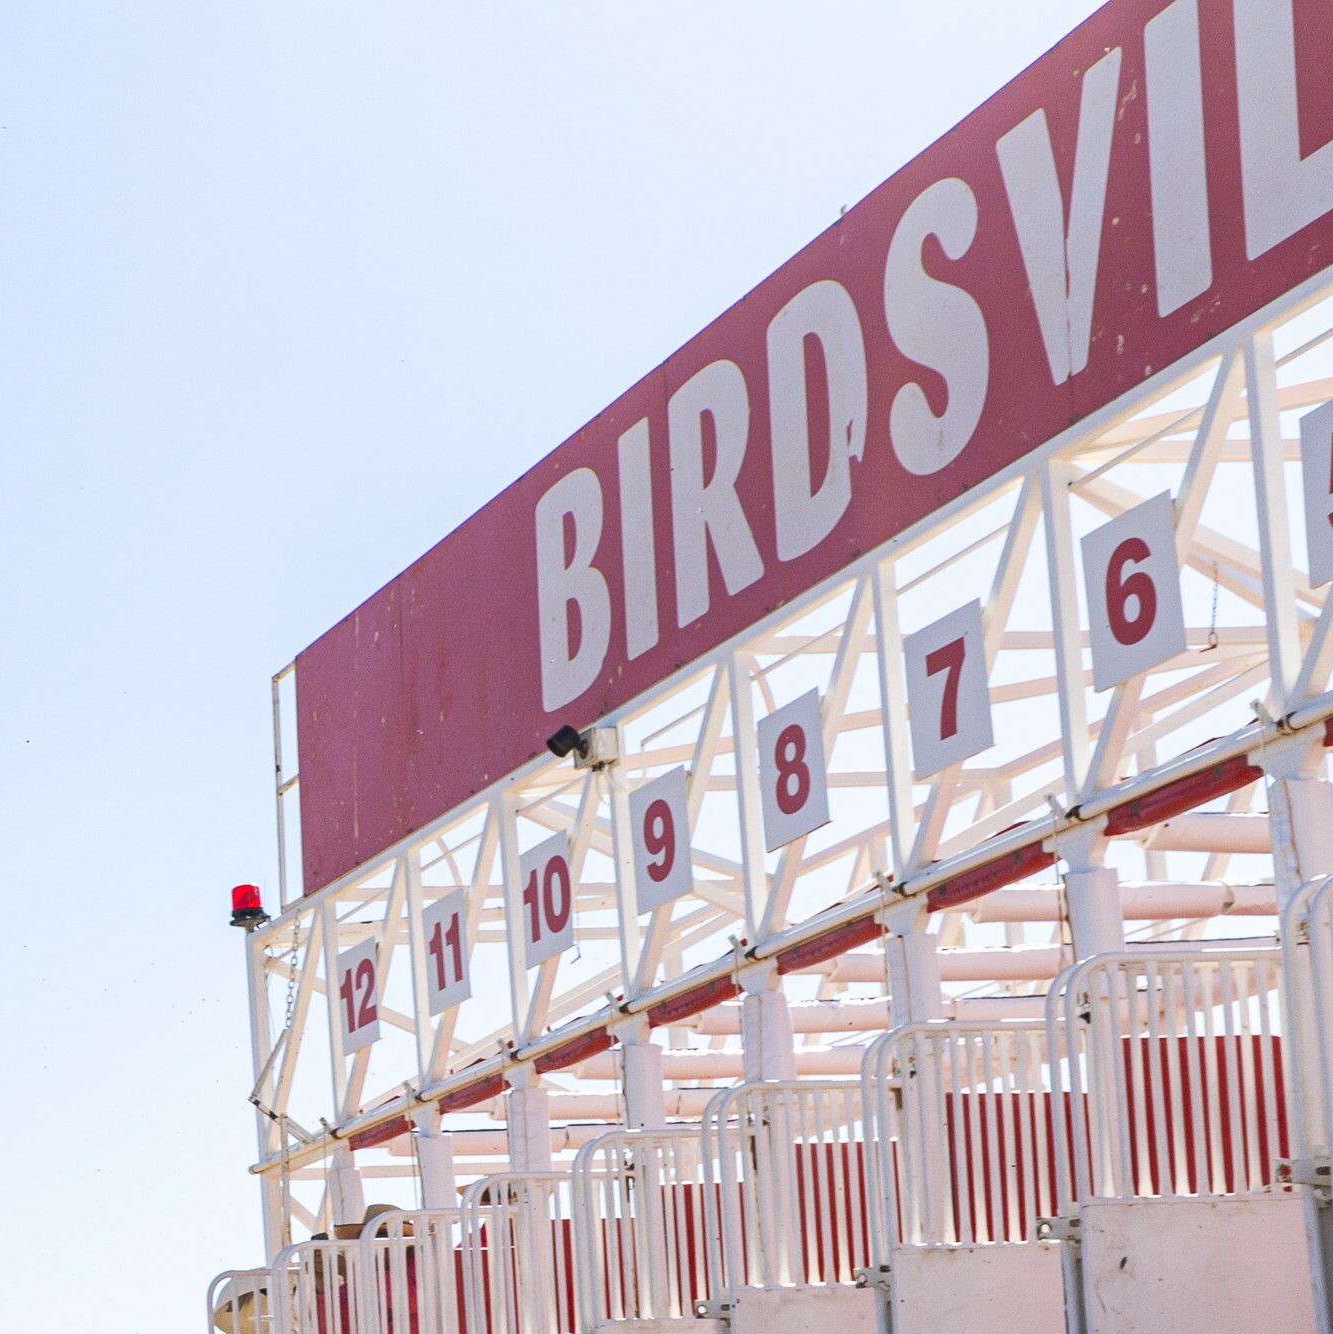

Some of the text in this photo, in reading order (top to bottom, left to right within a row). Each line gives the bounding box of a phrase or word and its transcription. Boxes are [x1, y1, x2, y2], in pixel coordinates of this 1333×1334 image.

[534, 0, 1333, 714] BIRDSVIL
[1105, 538, 1156, 646] 6
[924, 637, 965, 740] 7
[774, 725, 810, 815] 8
[642, 799, 675, 883] 9
[522, 854, 571, 942] 10
[339, 957, 377, 1033] 12
[429, 914, 464, 987] 11
